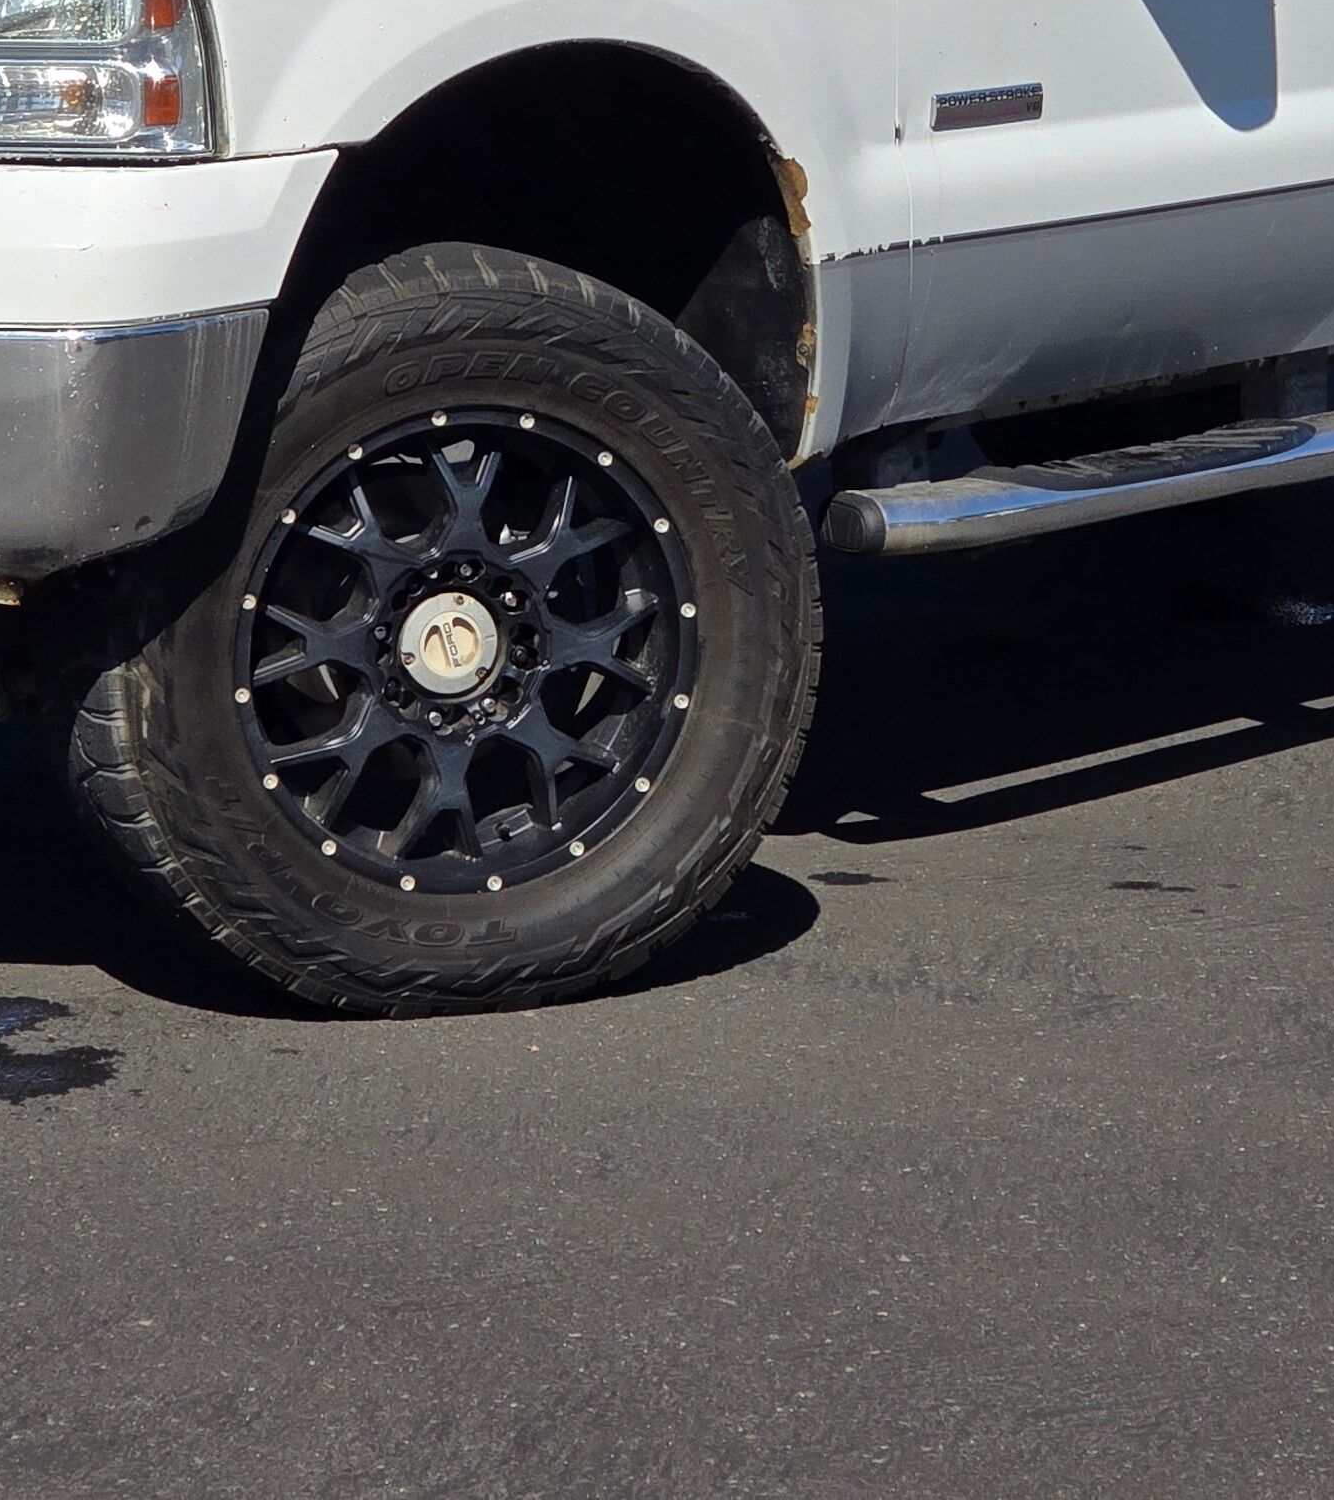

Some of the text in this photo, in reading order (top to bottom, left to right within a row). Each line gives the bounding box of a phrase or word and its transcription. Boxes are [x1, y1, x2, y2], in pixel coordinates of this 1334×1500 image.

[383, 350, 755, 597] OPEN COUNTRY
[443, 622, 462, 667] FORD
[311, 891, 517, 947] TOYO
